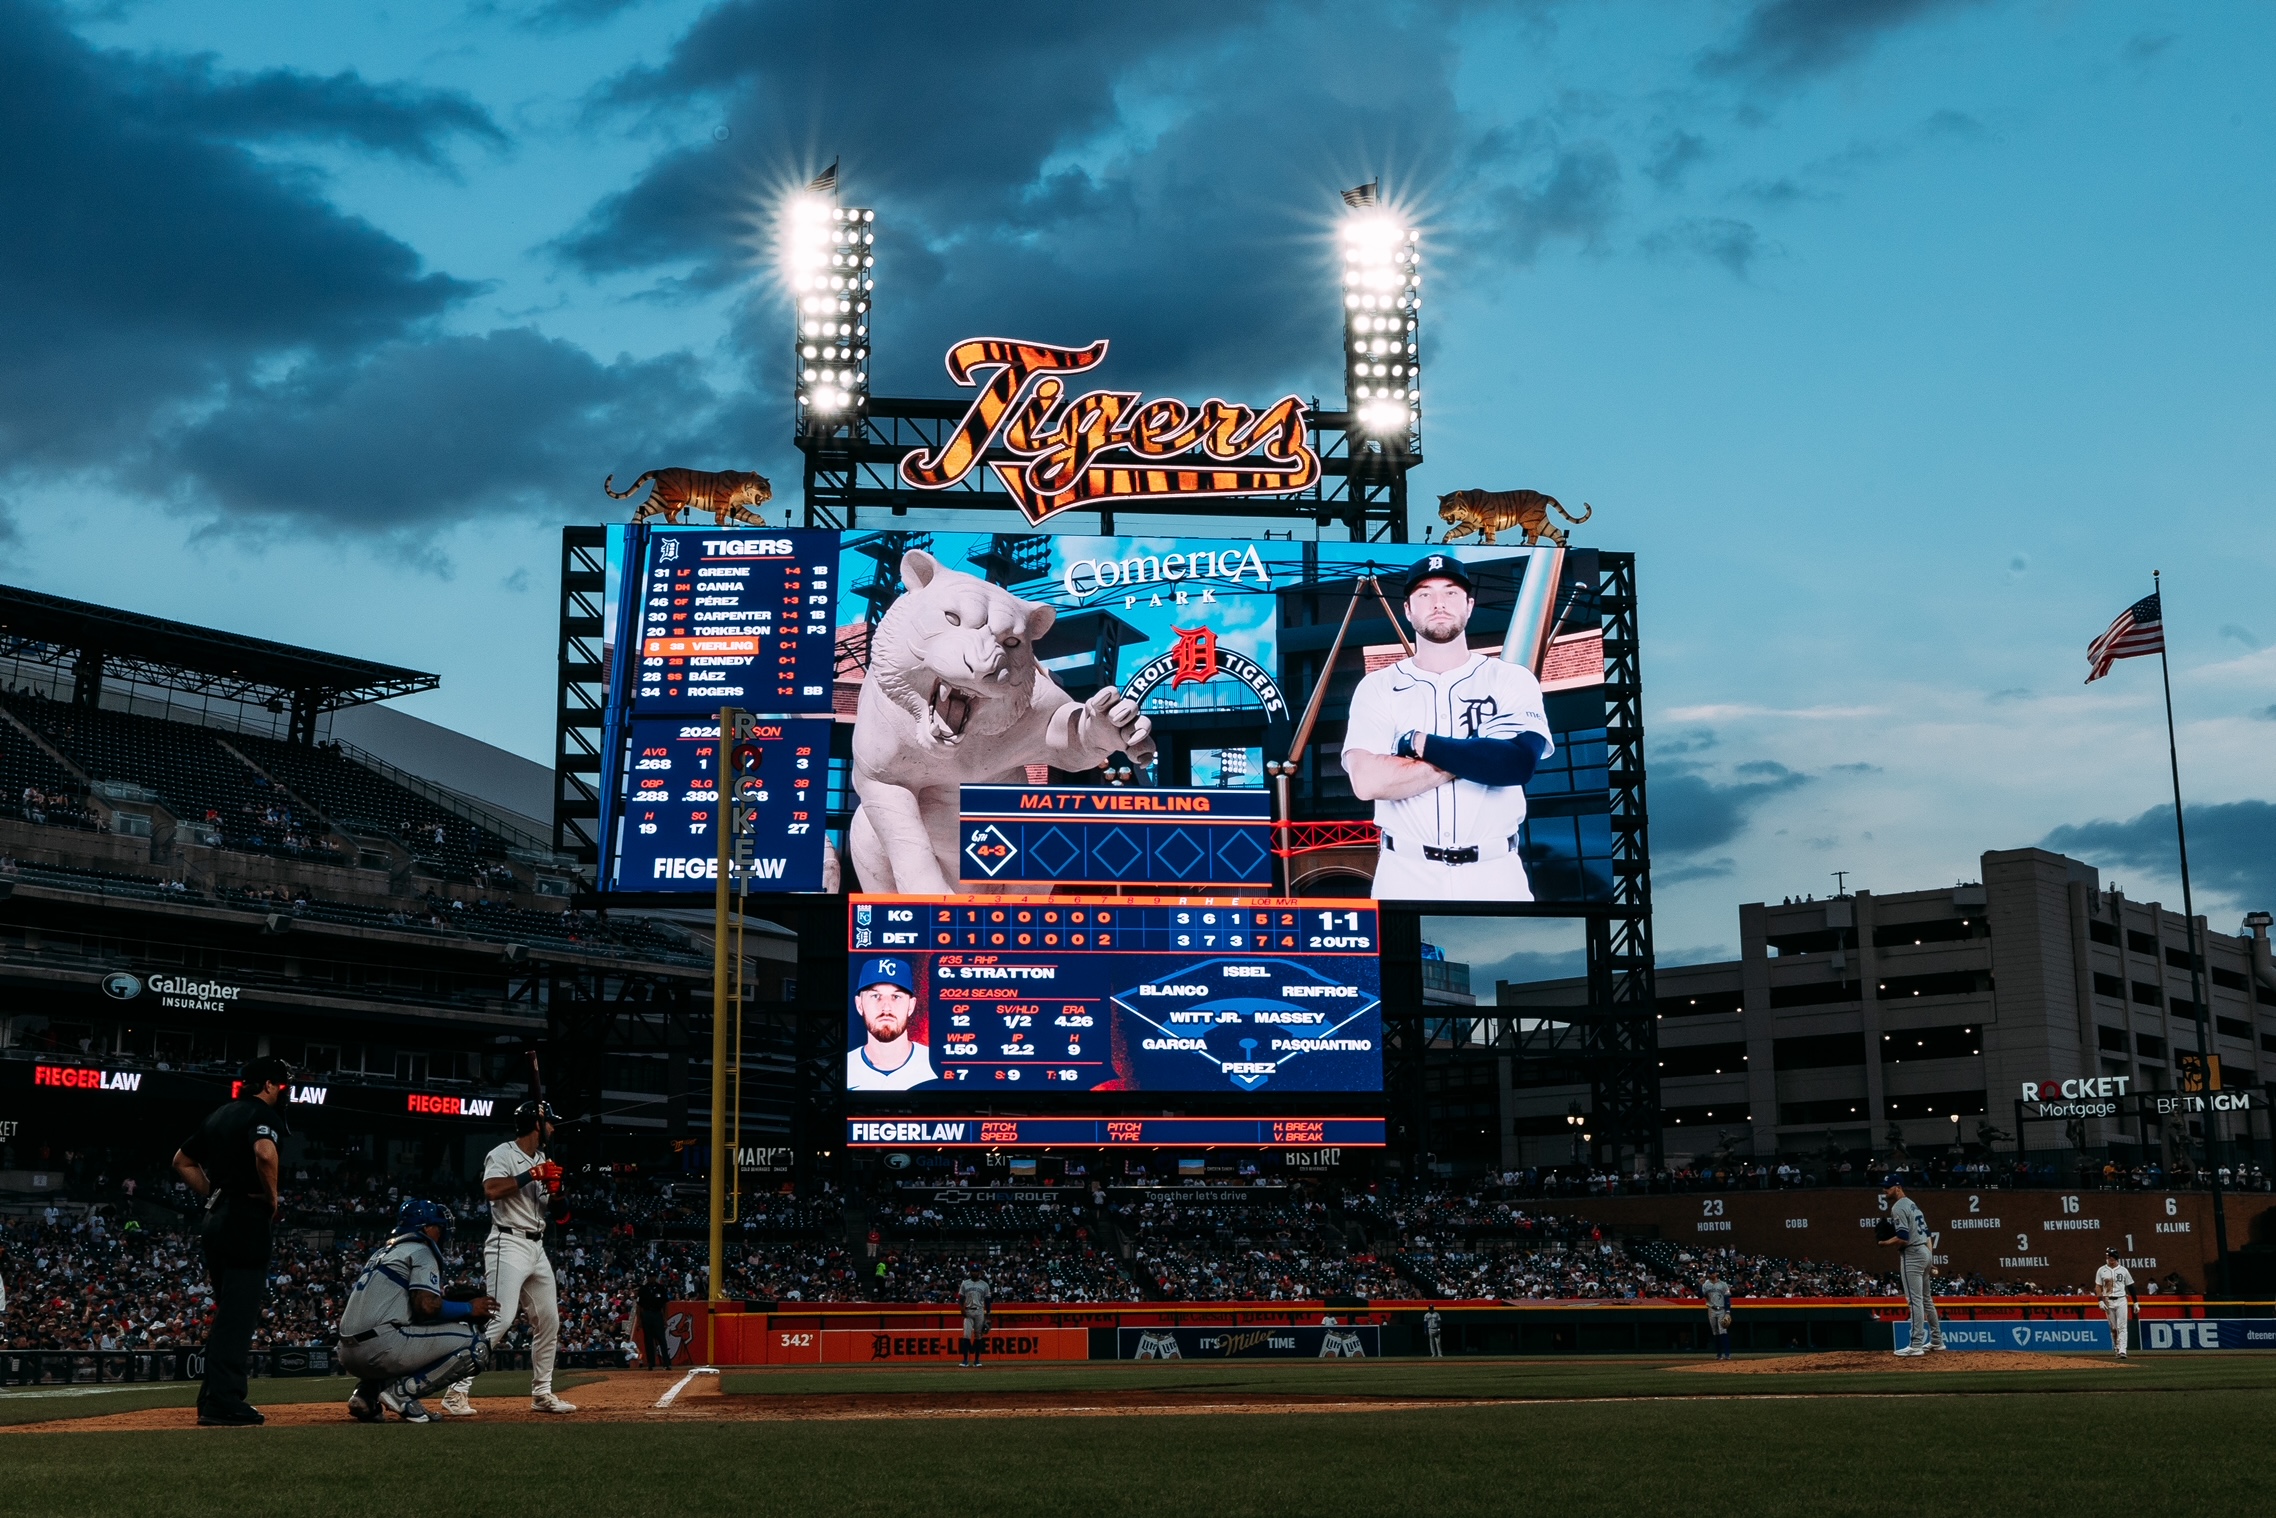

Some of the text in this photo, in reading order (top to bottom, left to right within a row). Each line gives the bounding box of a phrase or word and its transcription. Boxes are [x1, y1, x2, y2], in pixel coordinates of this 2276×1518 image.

[899, 336, 1321, 527] Tigers
[703, 540, 793, 556] TIGERS
[654, 569, 669, 577] 31
[698, 568, 750, 577] GREENE
[784, 567, 800, 575] 1-4
[812, 566, 828, 575] 1B
[653, 583, 668, 592] 21
[697, 583, 744, 591] CANHA
[812, 581, 827, 590] 1B
[649, 598, 668, 607] 46
[695, 596, 739, 606] PÉREZ
[809, 596, 827, 605] F9
[1125, 589, 1216, 609] PARK
[648, 613, 667, 621] 30
[694, 612, 771, 621] CARPENTER
[782, 611, 798, 619] 1-4
[810, 610, 825, 619] 1B
[647, 628, 665, 636] 20
[693, 626, 770, 636] TORKELSON
[807, 625, 826, 635] P3
[692, 642, 753, 651] VIERLING
[780, 641, 796, 649] 0-1
[643, 658, 663, 666] 40
[690, 657, 754, 666] KENNEDY
[642, 673, 661, 681] 28
[689, 671, 725, 681] BÁEZ
[778, 672, 794, 680] 1-3
[1226, 655, 1282, 712] TIGERS
[641, 686, 823, 697] 34 ROGERS 1-2 BB
[680, 727, 720, 737] 2024
[643, 748, 667, 756] AVG
[696, 748, 712, 756] HR
[635, 759, 808, 769] .268 3
[641, 780, 663, 788] OBP
[691, 780, 712, 788] SLG
[632, 792, 718, 801] .288 .380
[731, 713, 762, 897] ROCKET
[1020, 794, 1210, 811] MATT VIERLING
[793, 812, 808, 820] TB
[639, 824, 809, 834] 19 17 27
[971, 830, 987, 843] 6TH
[978, 846, 1005, 856] 4-3
[888, 911, 1216, 925] KC 3 6
[1318, 912, 1358, 931] 1-1
[883, 933, 1243, 946] DET 3 7 3
[1310, 937, 1370, 948] 2 OUTS
[939, 956, 962, 964] #35
[938, 968, 1054, 979] C. STRATTON
[1223, 966, 1270, 977] ISBEL
[148, 974, 240, 1000] Gallagher
[1140, 985, 1358, 997] BLANCO RENFROE
[971, 989, 1018, 997] SEASON
[162, 997, 225, 1012] INSURANCE
[952, 1006, 1085, 1014] GP SV/HLD ERA
[951, 1016, 1093, 1027] 12 1/2 4.26
[1170, 1012, 1324, 1023] WITT JR. MASSEY
[947, 1034, 1023, 1042] WHIP IP
[943, 1044, 1034, 1055] 1.50 12.2
[1142, 1039, 1371, 1052] GARCIA PASQUANTINO
[1222, 1063, 1276, 1073] PEREZ
[34, 1066, 141, 1091] FIEGERLAW
[957, 1070, 1078, 1080] 7 9 16
[2022, 1076, 2129, 1102] ROCKET
[408, 1095, 493, 1116] FIEGERLAW
[2040, 1103, 2116, 1118] Mortgage
[853, 1123, 965, 1141] FIEGERLAW
[982, 1123, 1017, 1131] PITCH
[1107, 1123, 1142, 1131] PITCH
[1286, 1123, 1323, 1131] BREAK
[980, 1132, 1018, 1141] SPEED
[1110, 1132, 1140, 1141] TYPE
[1286, 1133, 1323, 1141] BREAK
[987, 1156, 1012, 1166] EXIT
[977, 1192, 1059, 1200] CHEVROLET
[1145, 1191, 1247, 1201] Together let's drive
[1703, 1200, 1723, 1216] 23
[1878, 1194, 1888, 1211] 5
[1969, 1196, 1980, 1212] 2
[2061, 1196, 2079, 1213] 16
[2166, 1198, 2176, 1216] 6
[1697, 1222, 1731, 1231] HORTON
[1786, 1219, 1808, 1228] COBB
[1951, 1218, 2000, 1229] GEHRINGER
[2044, 1219, 2100, 1231] NEWHOUSER
[2156, 1222, 2190, 1233] KALINE
[2017, 1234, 2028, 1251] 3
[2125, 1234, 2133, 1251] 1
[2000, 1257, 2049, 1267] TRAMMELL
[1941, 1331, 1995, 1343] ANDUEL
[2035, 1331, 2098, 1342] FANDUEL
[2150, 1323, 2219, 1348] DTE
[1200, 1330, 1296, 1356] IT'S Miller TIME
